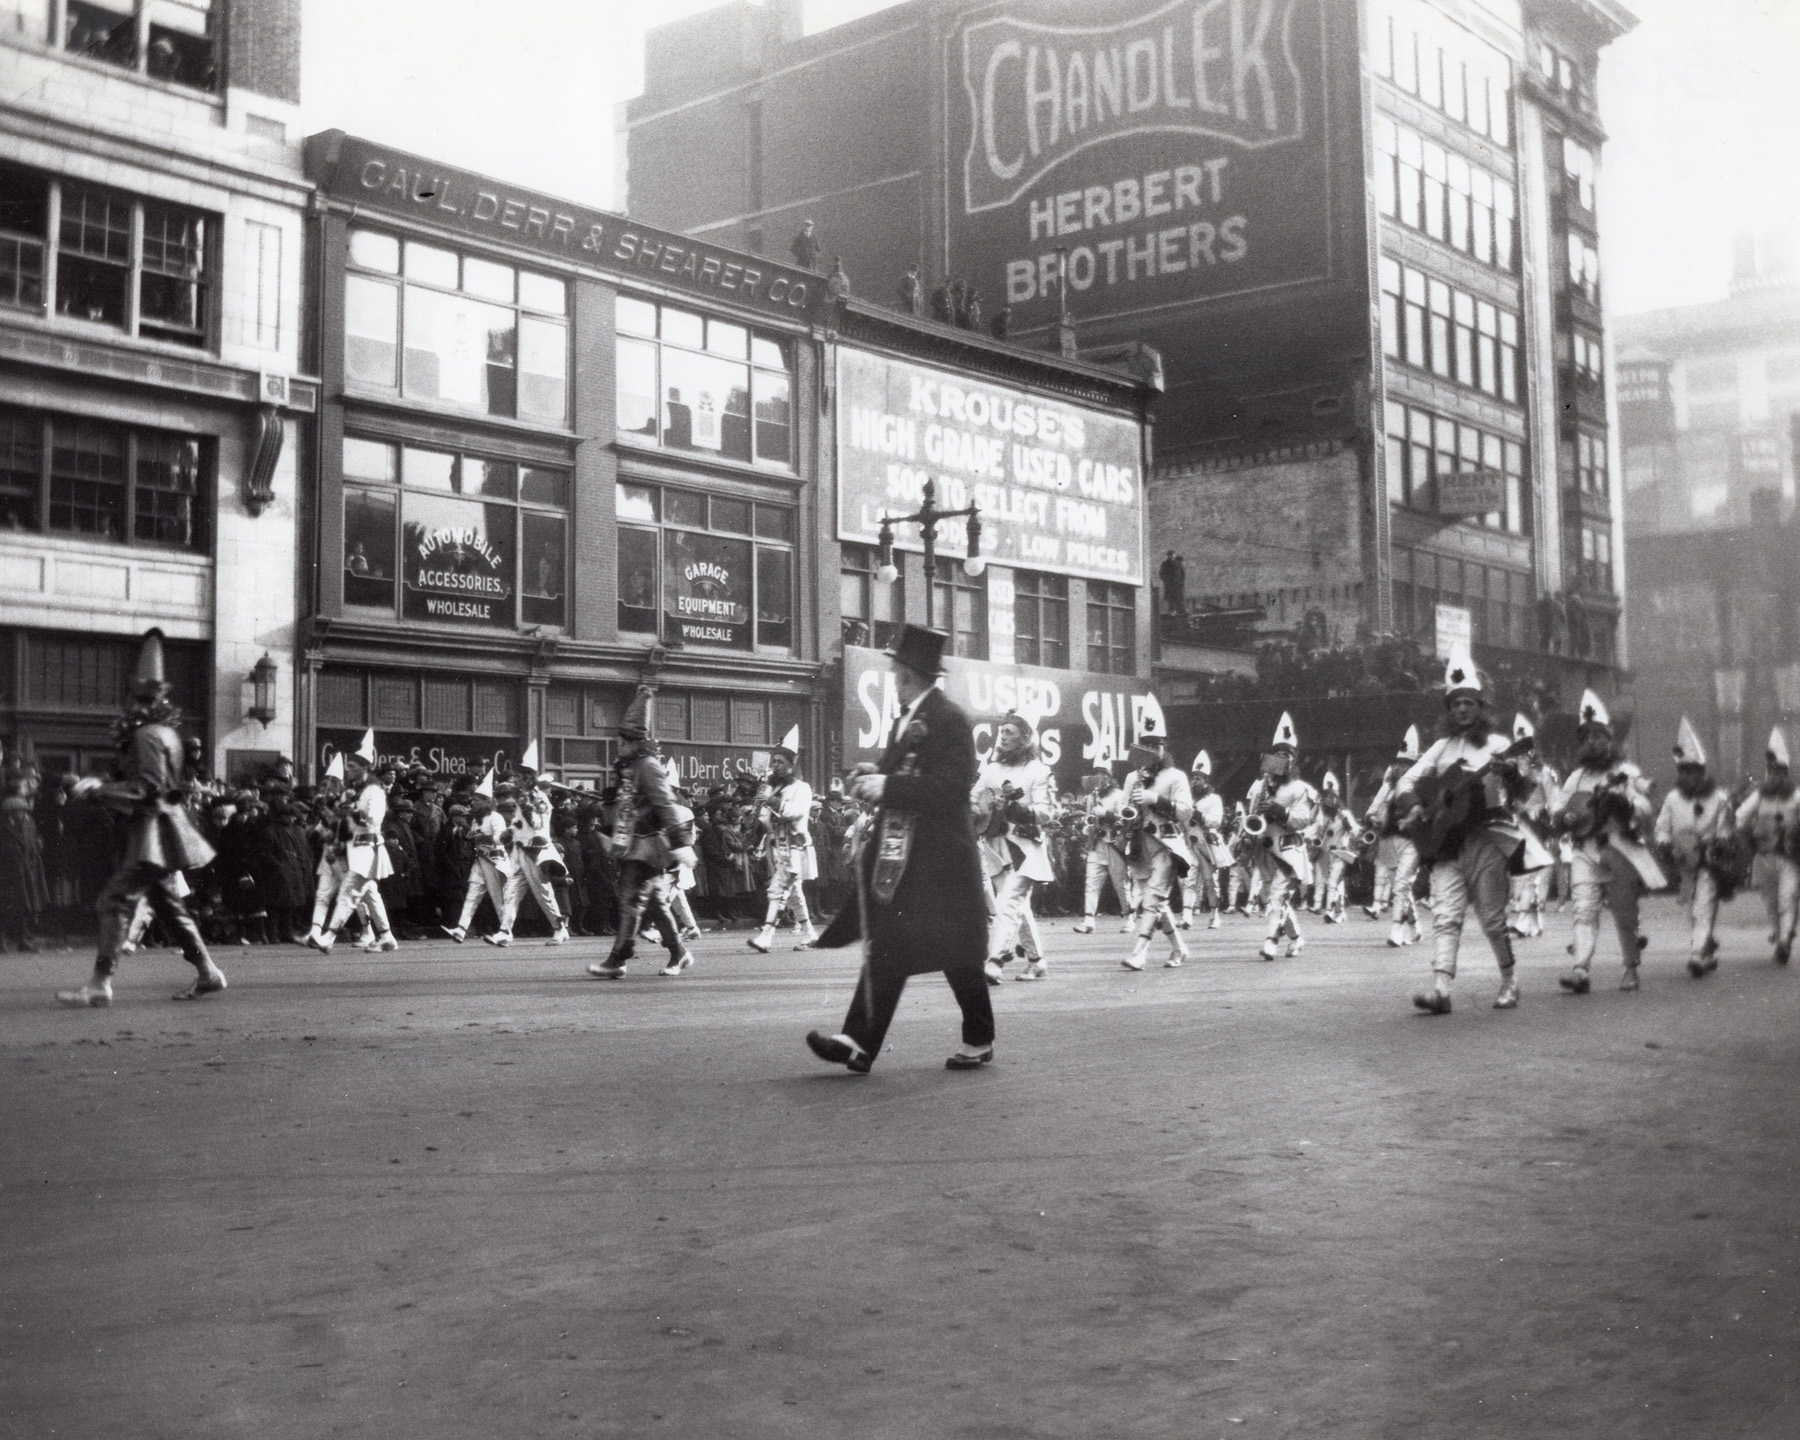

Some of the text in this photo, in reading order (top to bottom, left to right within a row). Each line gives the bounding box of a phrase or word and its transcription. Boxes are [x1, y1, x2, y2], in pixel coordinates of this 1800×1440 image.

[1029, 157, 1229, 242] HERBERT
[475, 192, 575, 247] DERR
[581, 225, 603, 252] &
[615, 233, 761, 297] SHEARER
[768, 277, 807, 309] CO.
[1007, 214, 1249, 303] BROTHERS
[849, 406, 1134, 503] HIGH GRADE USED CARS
[938, 475, 967, 509] TO
[974, 482, 1049, 525] SELECT
[1056, 498, 1107, 538] FROM
[417, 527, 502, 570] AUTOMOBILE
[1022, 533, 1060, 561] LOW
[1067, 545, 1130, 571] PRICES
[684, 562, 729, 585] GARAGE
[427, 599, 491, 619] WHOLESALE
[678, 596, 737, 617] EQUIPMENT
[682, 624, 733, 642] WHOLESALE
[966, 671, 1061, 718] USED
[428, 747, 490, 775] Shear
[972, 722, 1062, 765] CS
[690, 756, 719, 780] Derr
[722, 757, 733, 780] &
